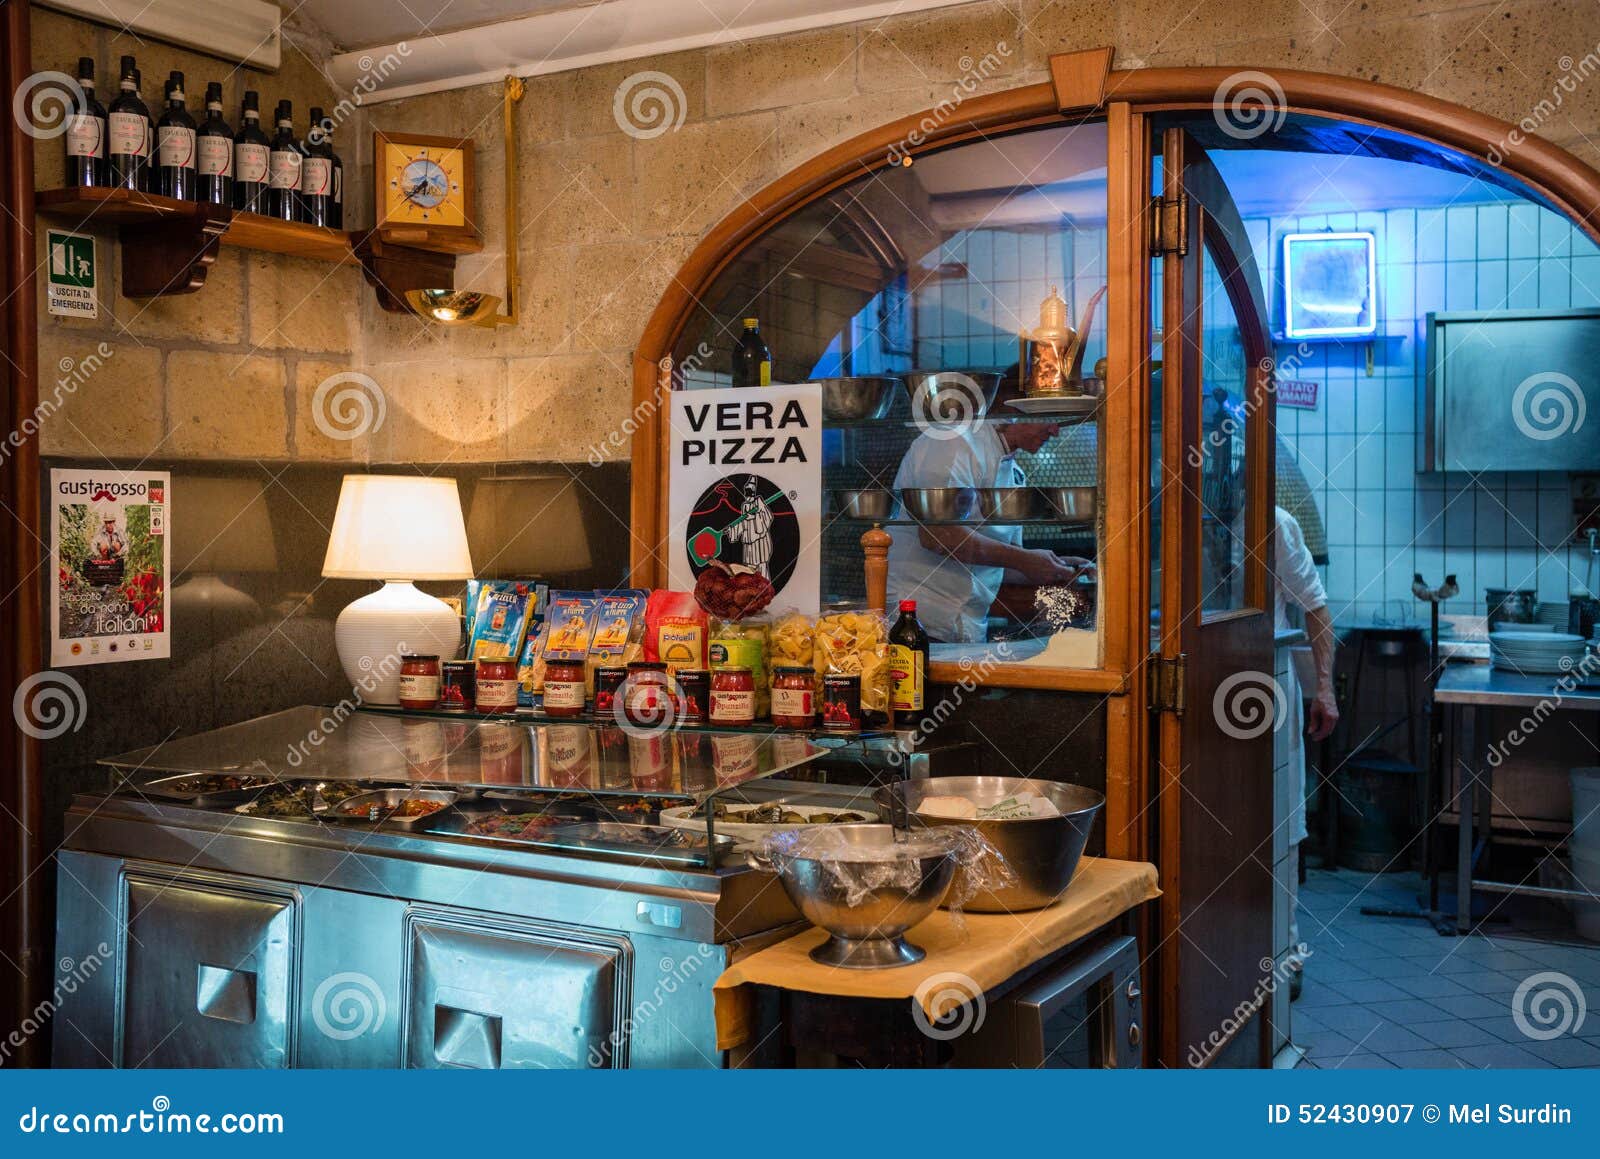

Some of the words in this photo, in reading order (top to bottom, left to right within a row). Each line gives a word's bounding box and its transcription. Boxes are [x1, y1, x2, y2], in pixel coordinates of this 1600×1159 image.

[56, 287, 82, 298] USCITA
[83, 290, 91, 299] DI
[52, 298, 95, 311] EMERGENZA
[683, 400, 809, 432] VERA
[682, 436, 808, 466] PIZZA
[80, 603, 96, 614] da
